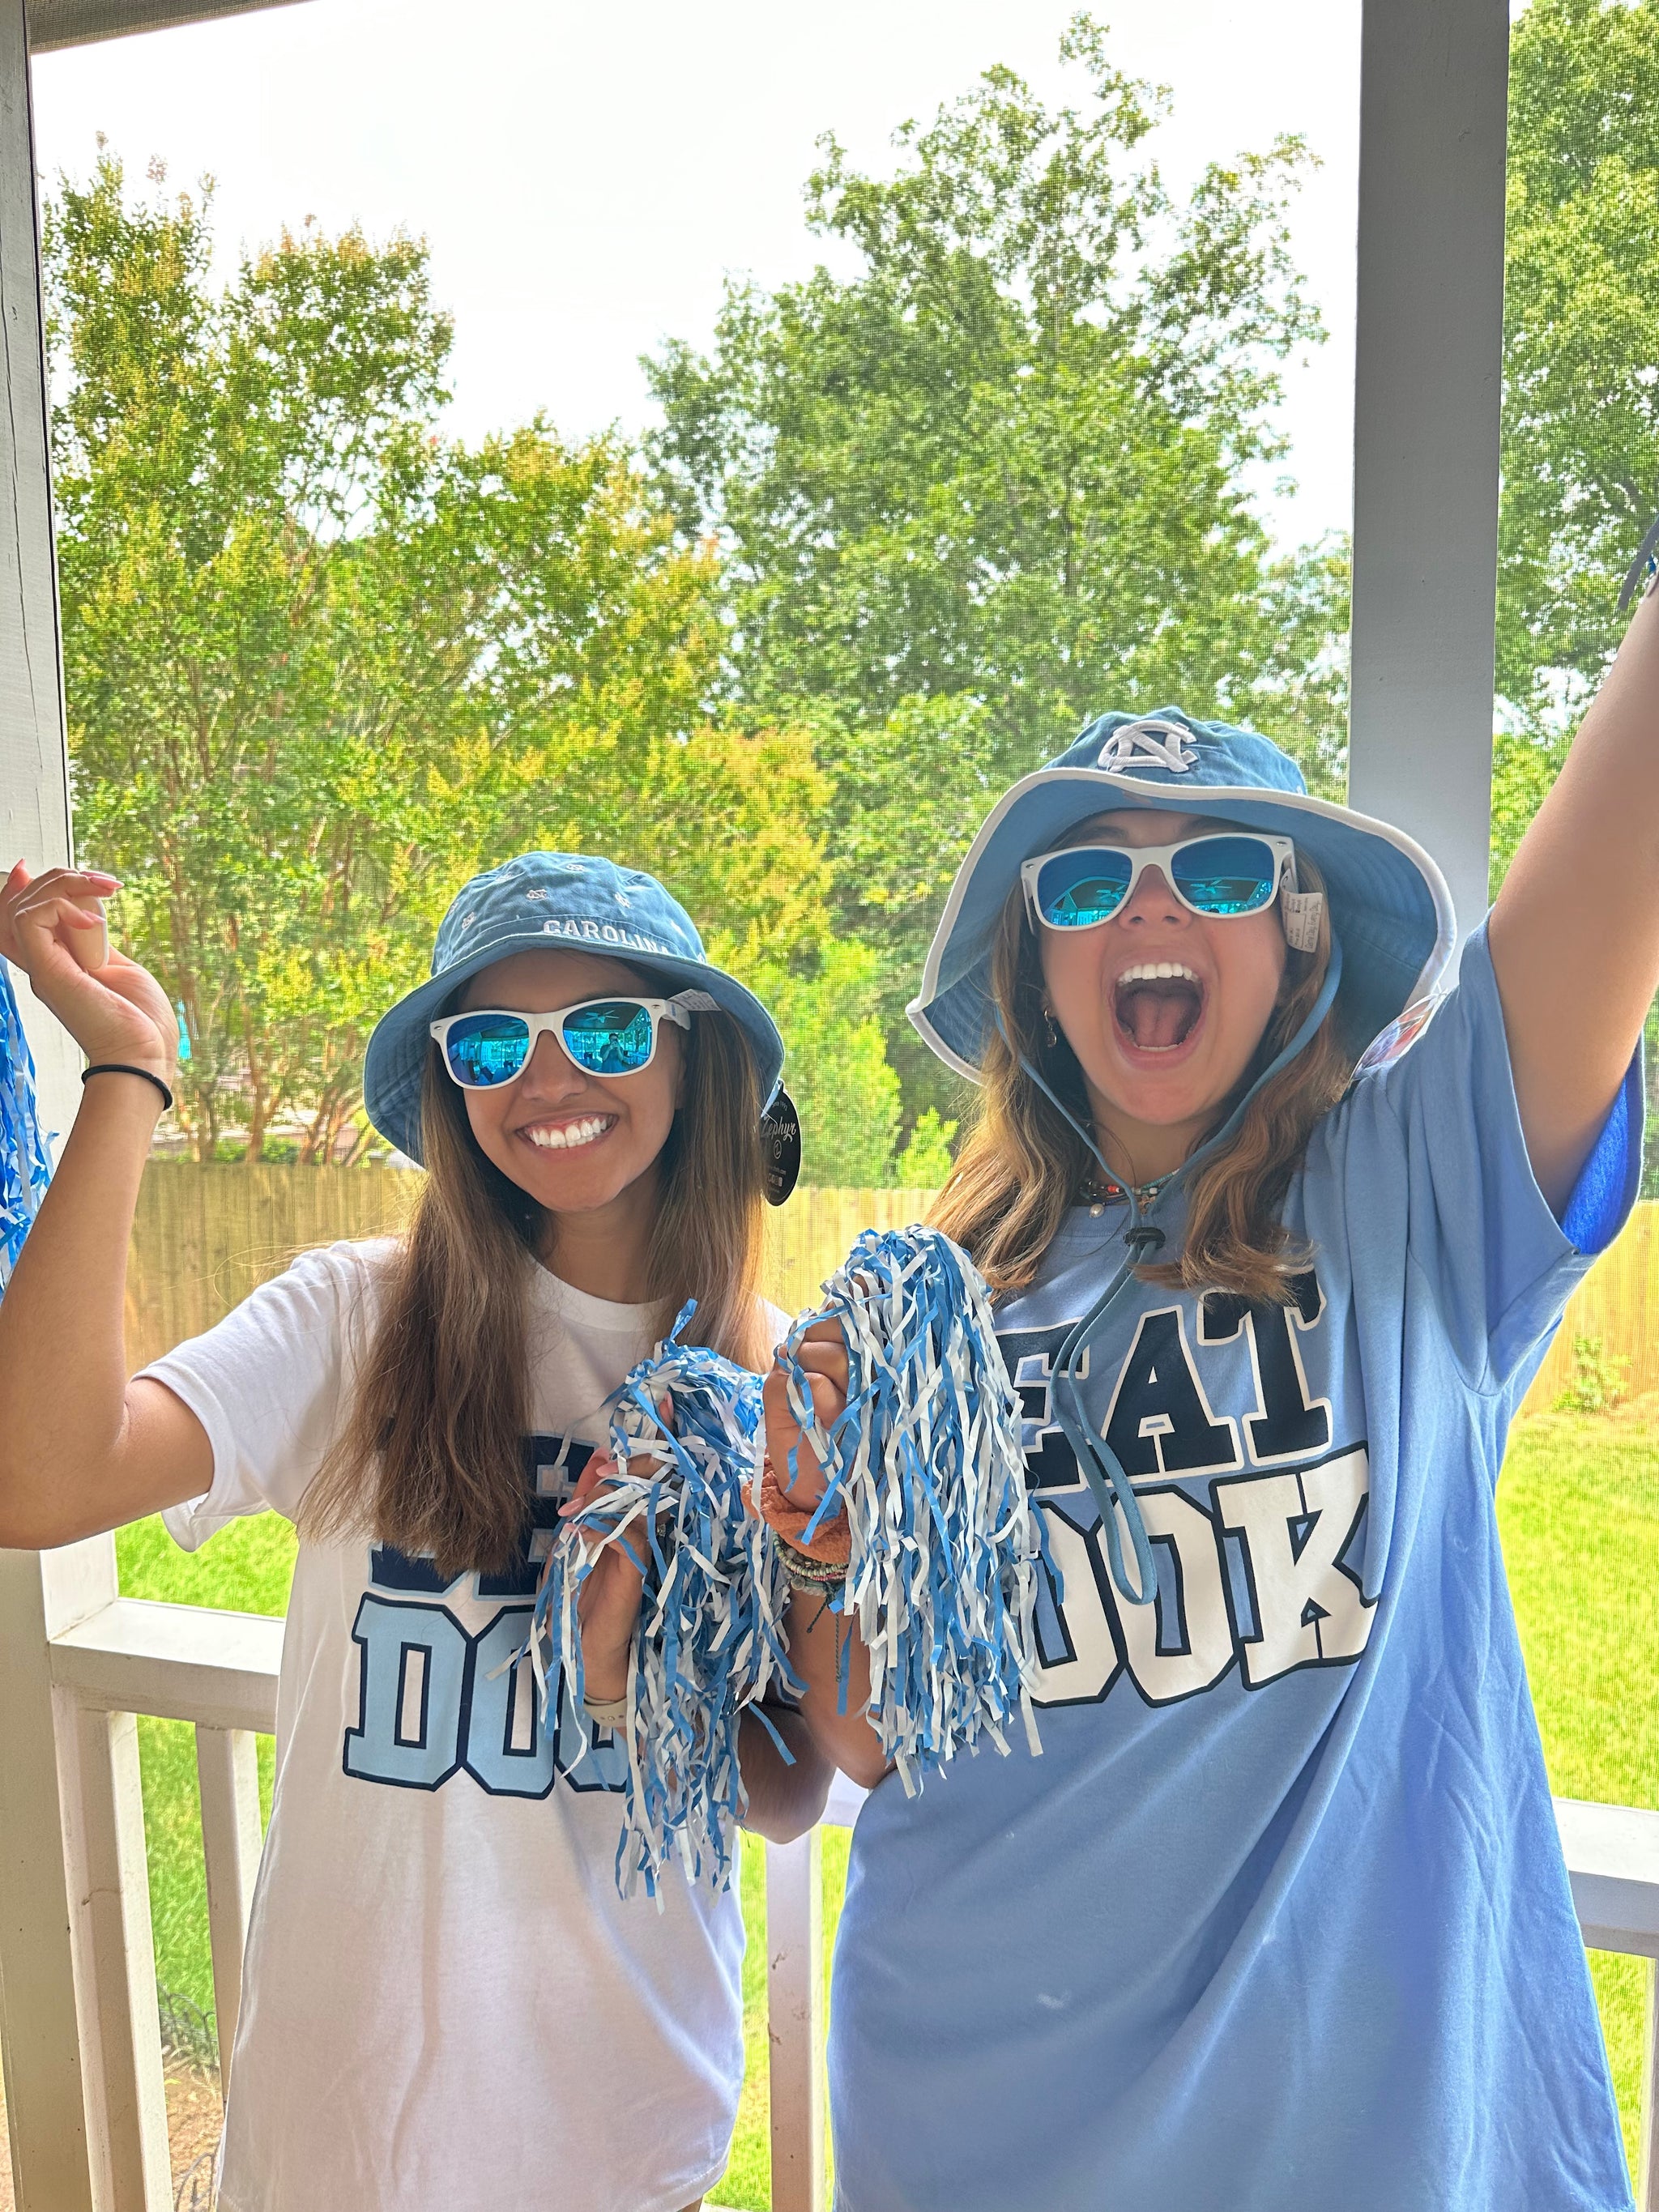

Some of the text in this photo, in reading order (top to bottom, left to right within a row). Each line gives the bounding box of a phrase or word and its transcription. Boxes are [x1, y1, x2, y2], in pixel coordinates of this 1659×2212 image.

[544, 919, 669, 954] CAROLINA
[761, 1116, 796, 1143] Zephyr
[994, 1265, 1333, 1497] EAT
